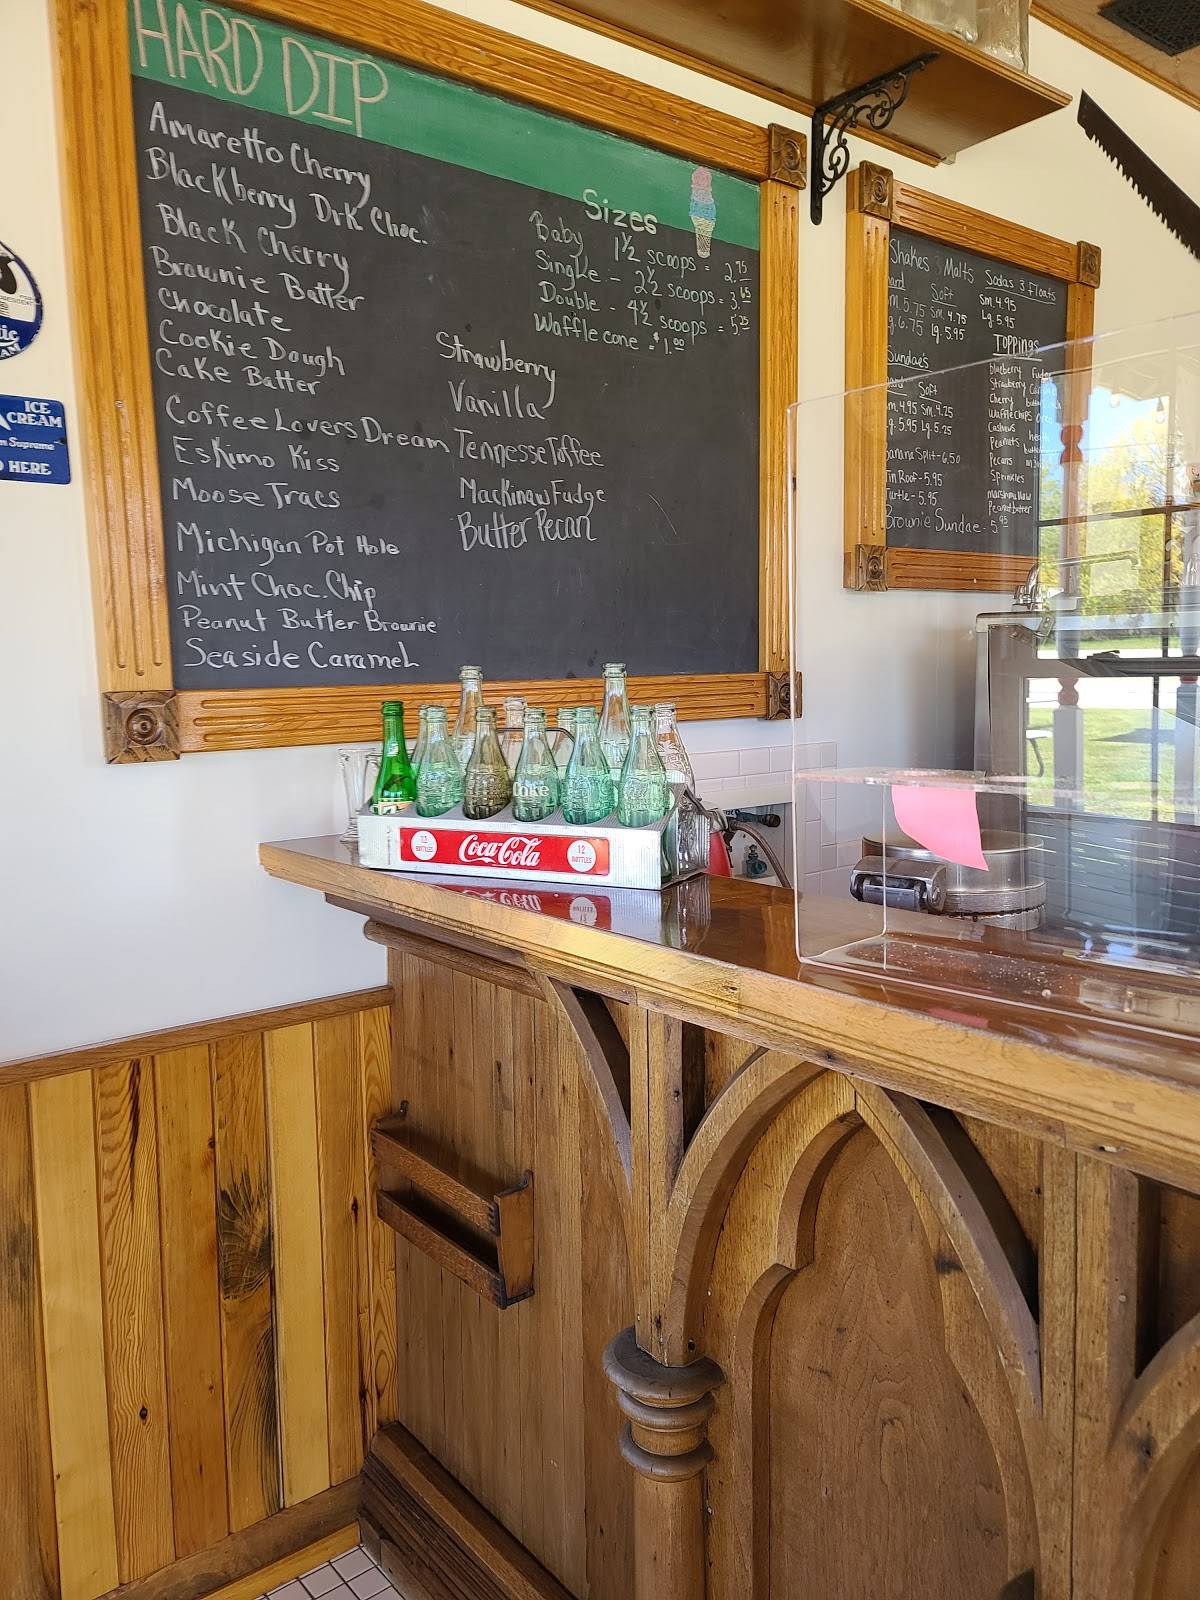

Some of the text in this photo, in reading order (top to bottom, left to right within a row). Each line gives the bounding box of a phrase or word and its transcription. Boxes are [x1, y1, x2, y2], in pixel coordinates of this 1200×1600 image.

[132, 0, 389, 138] HARD DIP
[149, 100, 371, 209] Amaretto Cherry
[581, 187, 658, 236] Sizes
[528, 210, 585, 258] Baby
[256, 226, 350, 299] Cherry
[534, 249, 602, 292] Single
[943, 256, 976, 285] Malts
[148, 245, 366, 312] Brownie Batter
[930, 282, 955, 302] Soft
[983, 268, 1015, 290] Sodas
[1026, 281, 1058, 303] Floats
[157, 287, 293, 332] Chocolate
[537, 279, 602, 313] Double
[888, 294, 928, 319] m. 5.75
[532, 311, 600, 343] Waffle
[602, 328, 640, 351] cone
[887, 314, 898, 337] g.
[944, 326, 966, 341] 5.95
[947, 310, 968, 326] 4.75
[996, 314, 1017, 330] 5.95
[261, 336, 346, 378] Dough
[434, 331, 557, 410] Strawberry
[240, 365, 321, 396] Batter
[23, 400, 52, 415] ICE
[447, 379, 546, 421] Vanilla
[888, 400, 918, 416] m. 4.95
[989, 393, 1014, 411] Cherry
[6, 411, 63, 429] CREAM
[165, 394, 451, 453] Coffee Lovers Dream
[898, 417, 918, 434] 5.95
[287, 443, 341, 473] Kiss
[544, 434, 606, 468] Toffee
[989, 452, 1014, 469] Pecans
[8, 460, 53, 476] HERE
[923, 470, 944, 488] 5.95
[172, 476, 342, 510] Moose Tracs
[917, 490, 939, 507] 5.95
[456, 507, 598, 552] Butter Pecan
[934, 507, 982, 534] Sundae
[175, 521, 401, 568] Michigan Pot Hole
[176, 569, 246, 601] Mint
[324, 569, 378, 609] Chip
[176, 603, 438, 634] Peanut Butter Brownie
[183, 637, 301, 669] Seaside
[512, 781, 550, 798] Coke
[458, 834, 544, 868] Coca-Cola
[570, 855, 593, 865] BOTTLES
[576, 844, 587, 855] 12
